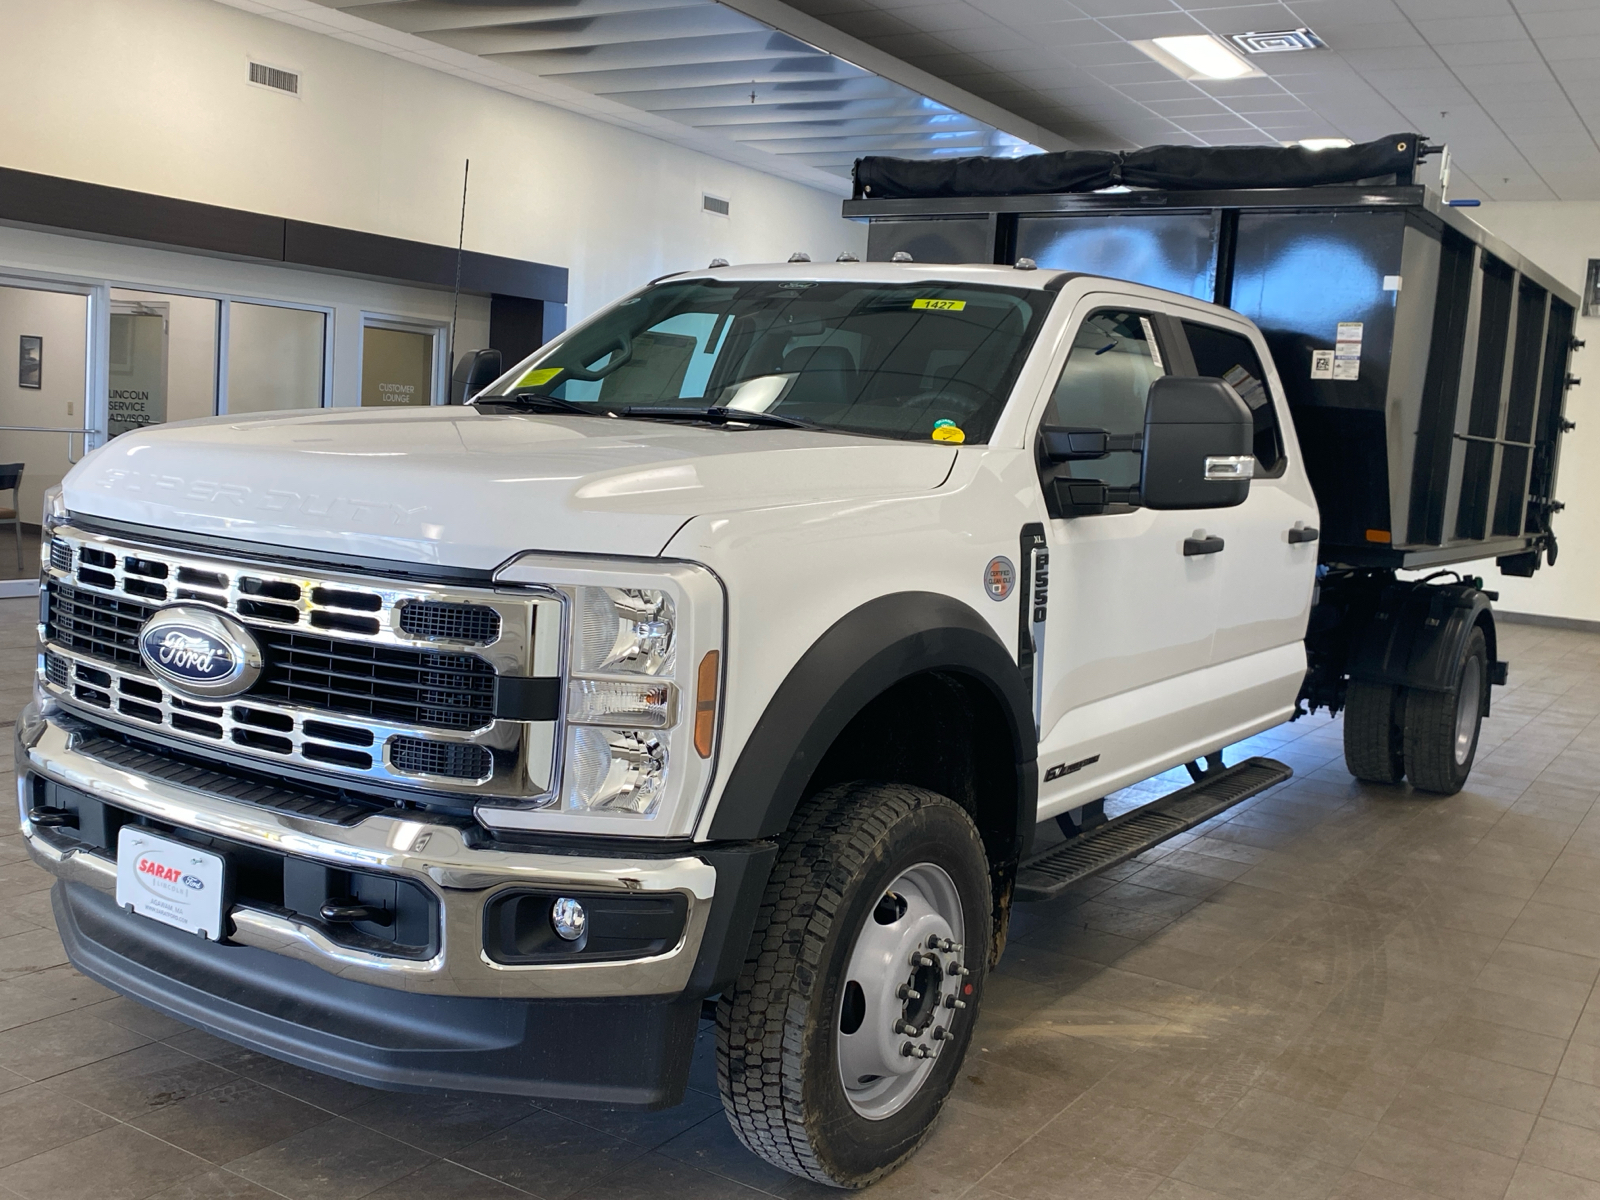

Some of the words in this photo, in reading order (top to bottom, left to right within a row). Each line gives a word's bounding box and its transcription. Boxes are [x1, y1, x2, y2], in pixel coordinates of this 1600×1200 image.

[925, 300, 955, 310] 1427
[378, 383, 414, 393] CUSTOMER
[108, 389, 149, 400] LINCOLN
[382, 393, 410, 403] LOUNGE
[108, 401, 146, 411] SERVICE
[108, 413, 150, 424] ADVISOR
[95, 469, 248, 503] SUPER
[257, 490, 431, 525] DUTY
[1034, 535, 1044, 543] XL
[1034, 553, 1049, 623] F550
[159, 631, 216, 673] Ford
[139, 859, 181, 883] SARAT
[157, 881, 184, 894] LINCOLN
[184, 875, 202, 889] Ford
